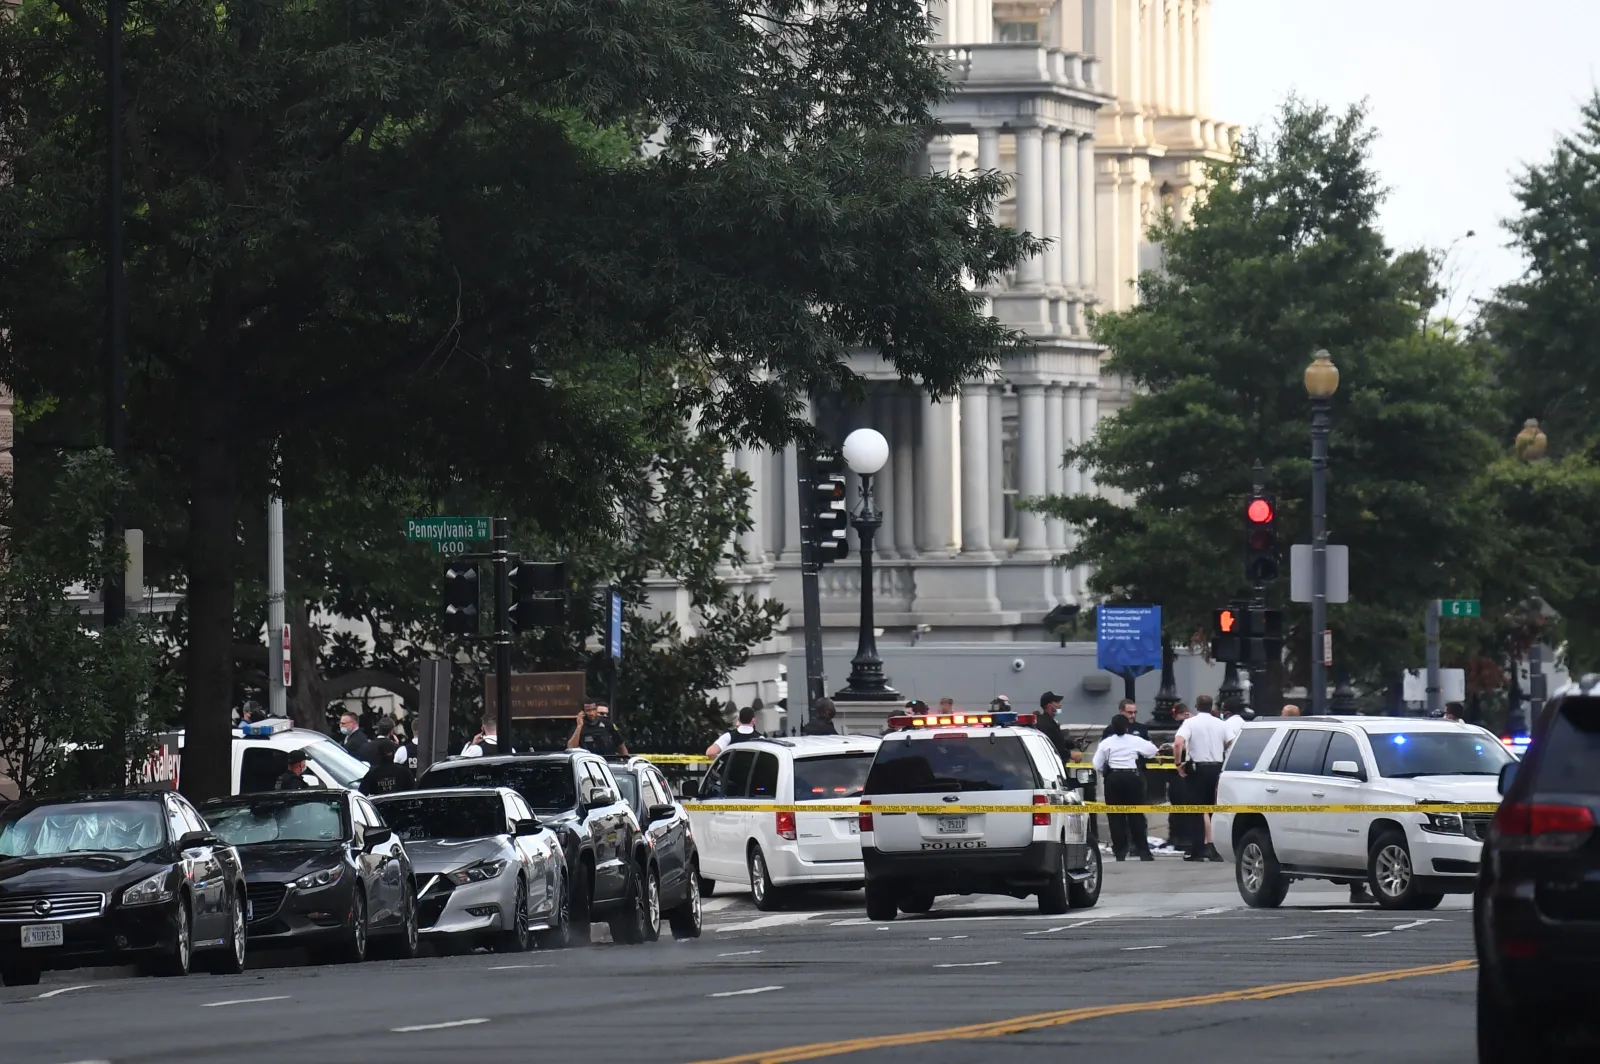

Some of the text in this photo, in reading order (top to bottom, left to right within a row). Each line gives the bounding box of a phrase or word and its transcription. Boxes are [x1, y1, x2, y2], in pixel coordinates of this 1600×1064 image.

[408, 520, 473, 540] Pennsylvania
[437, 541, 464, 553] 1600
[1453, 601, 1460, 615] G
[921, 841, 987, 850] POLICE
